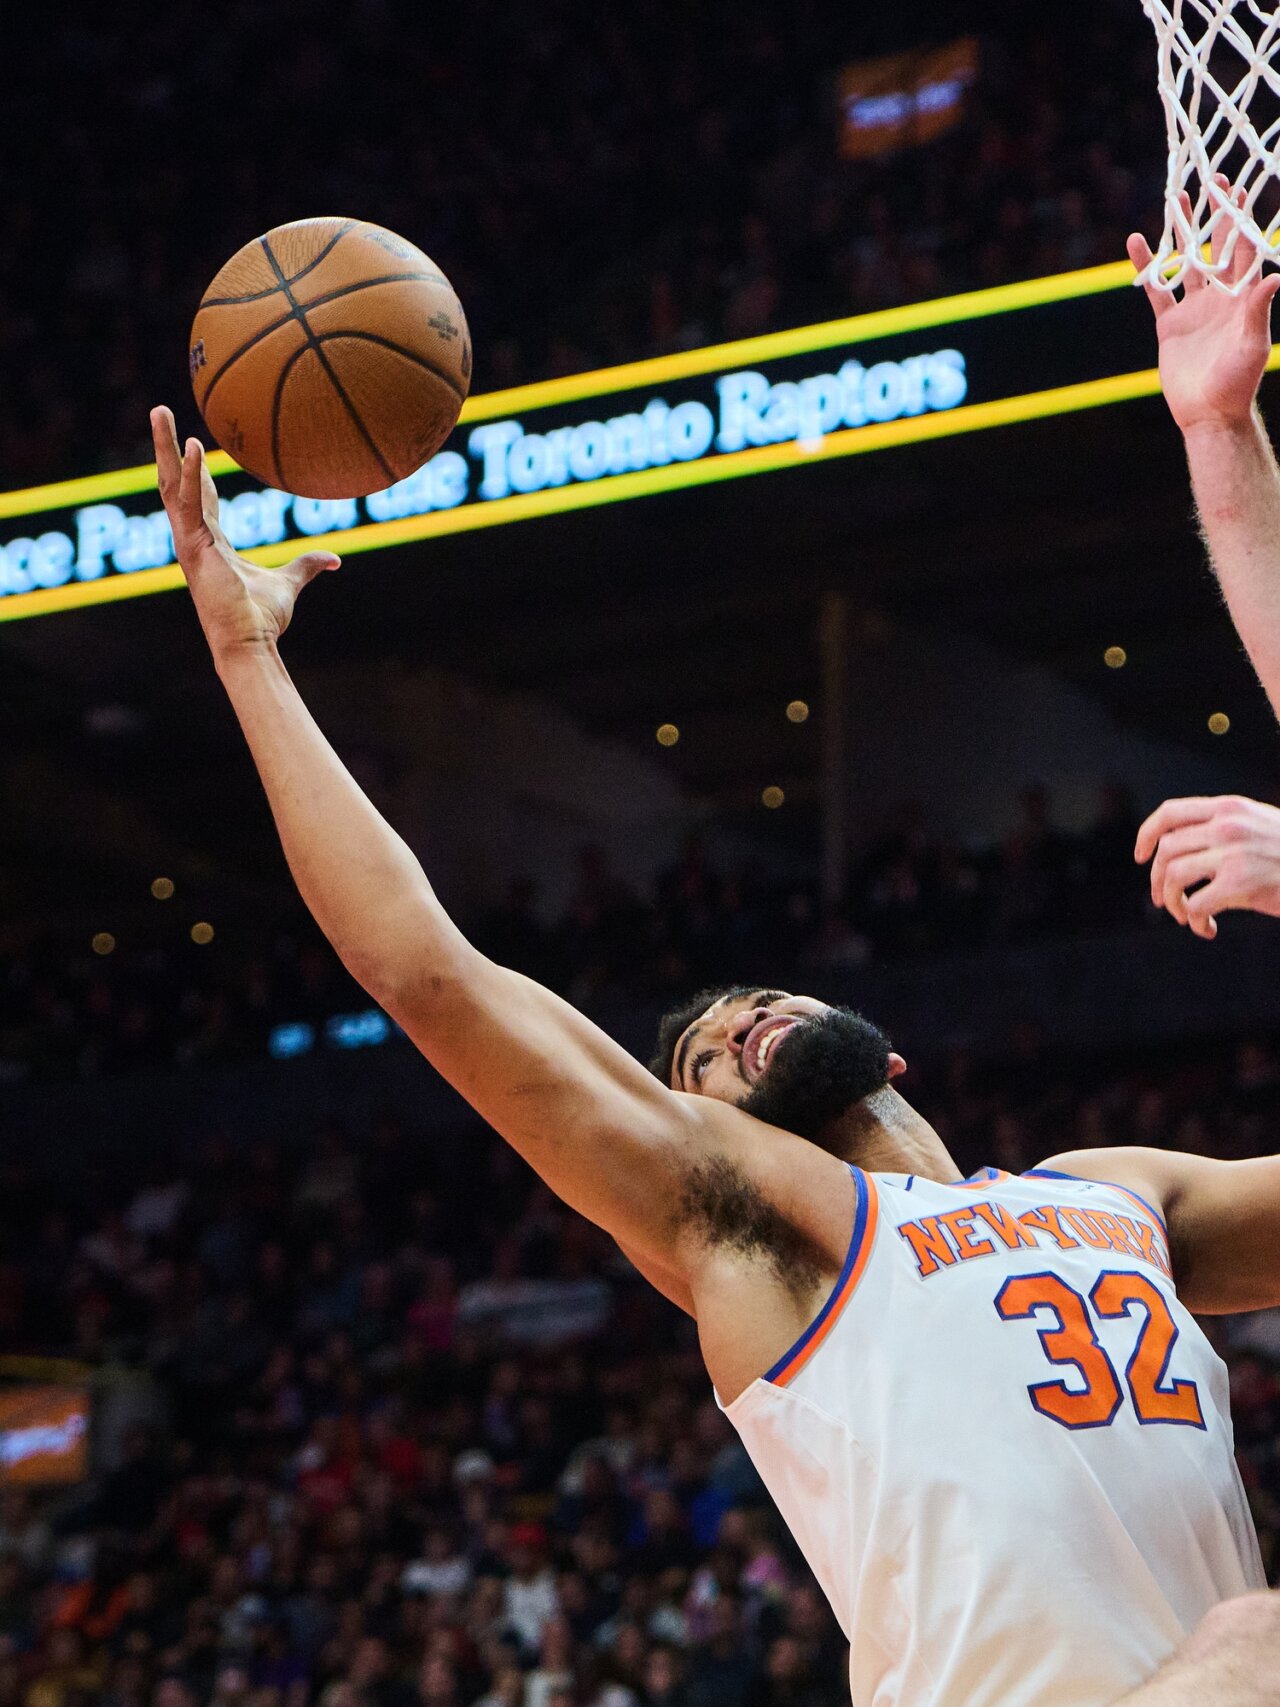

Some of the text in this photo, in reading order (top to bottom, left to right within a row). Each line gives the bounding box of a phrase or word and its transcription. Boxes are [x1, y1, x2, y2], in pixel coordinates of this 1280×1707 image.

[0, 532, 75, 597] ce
[75, 488, 293, 582] Parer
[469, 399, 713, 500] Toronto
[716, 348, 967, 453] Raptors
[897, 1202, 1173, 1279] NEW YORK
[993, 1270, 1207, 1431] 32
